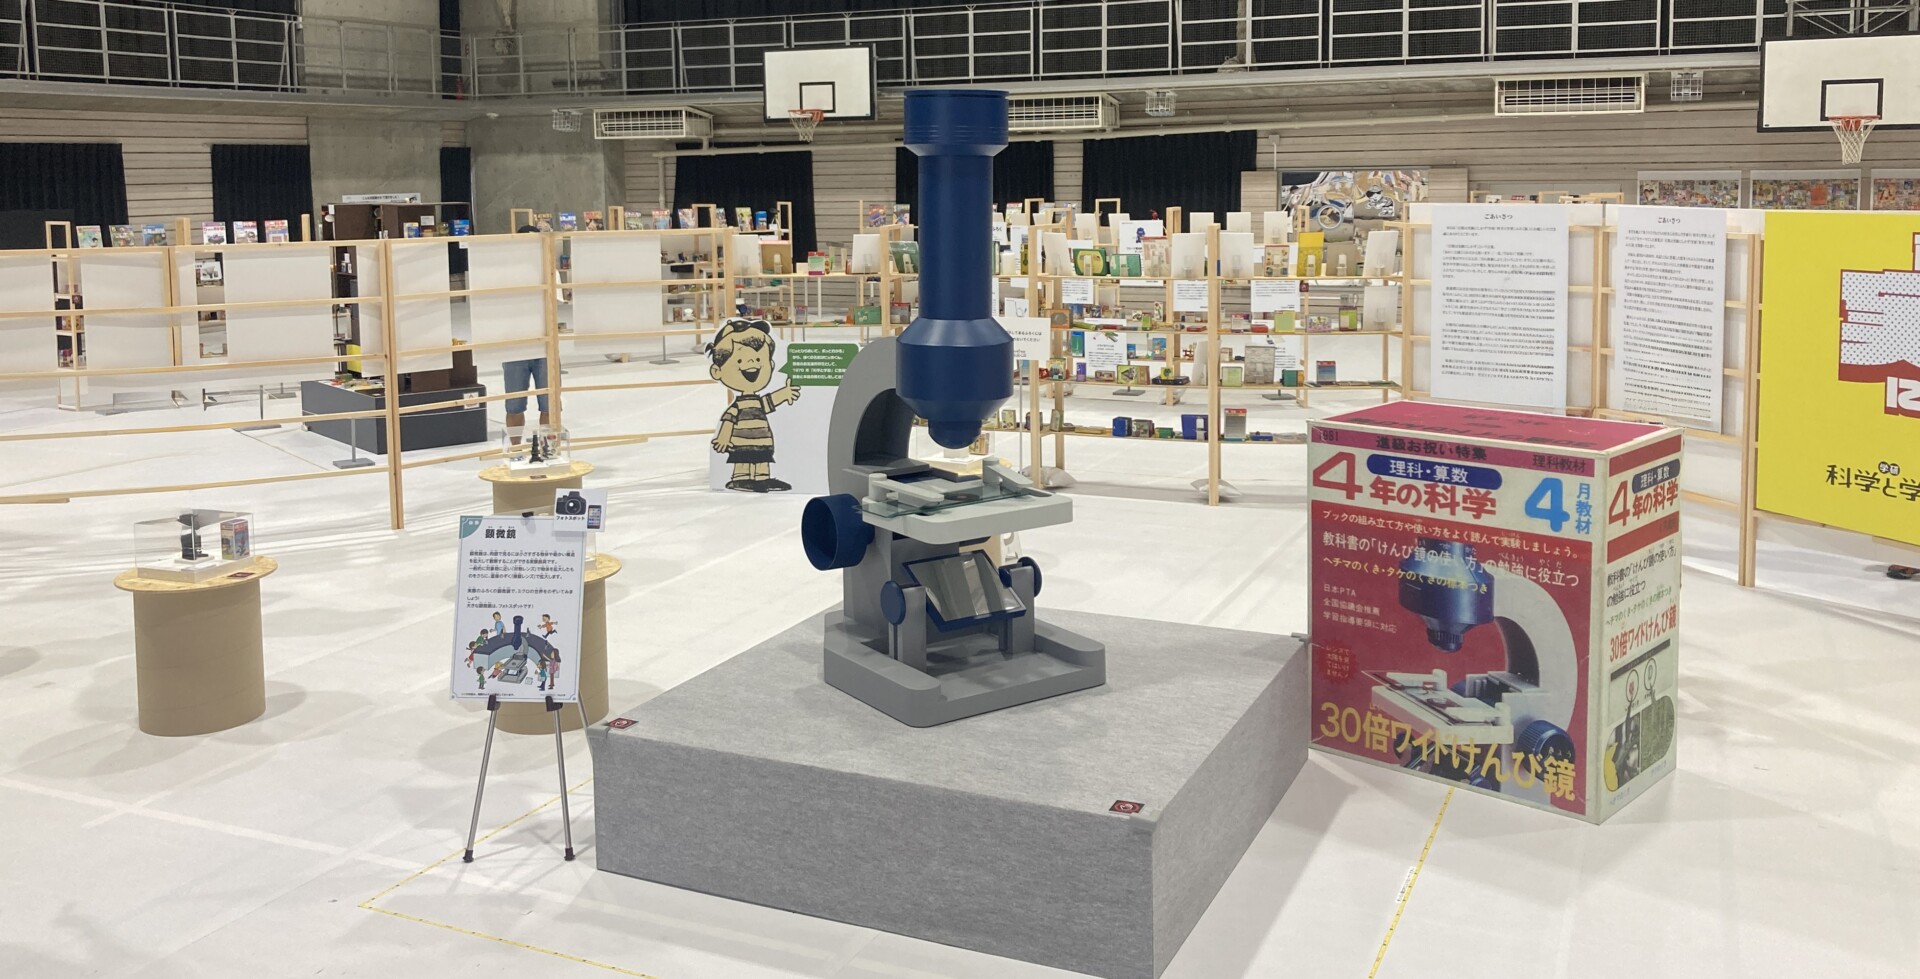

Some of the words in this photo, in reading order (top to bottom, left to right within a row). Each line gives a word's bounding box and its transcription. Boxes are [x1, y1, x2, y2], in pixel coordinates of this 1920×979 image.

[1484, 213, 1513, 221] ごあいさつ
[1376, 435, 1487, 461] 進級お祝い特集
[1389, 459, 1469, 485] 理科・算数
[1532, 454, 1586, 474] 理科教材
[485, 528, 516, 539] 顕微鏡
[1320, 701, 1577, 802] 30倍ワイドけんび鏡
